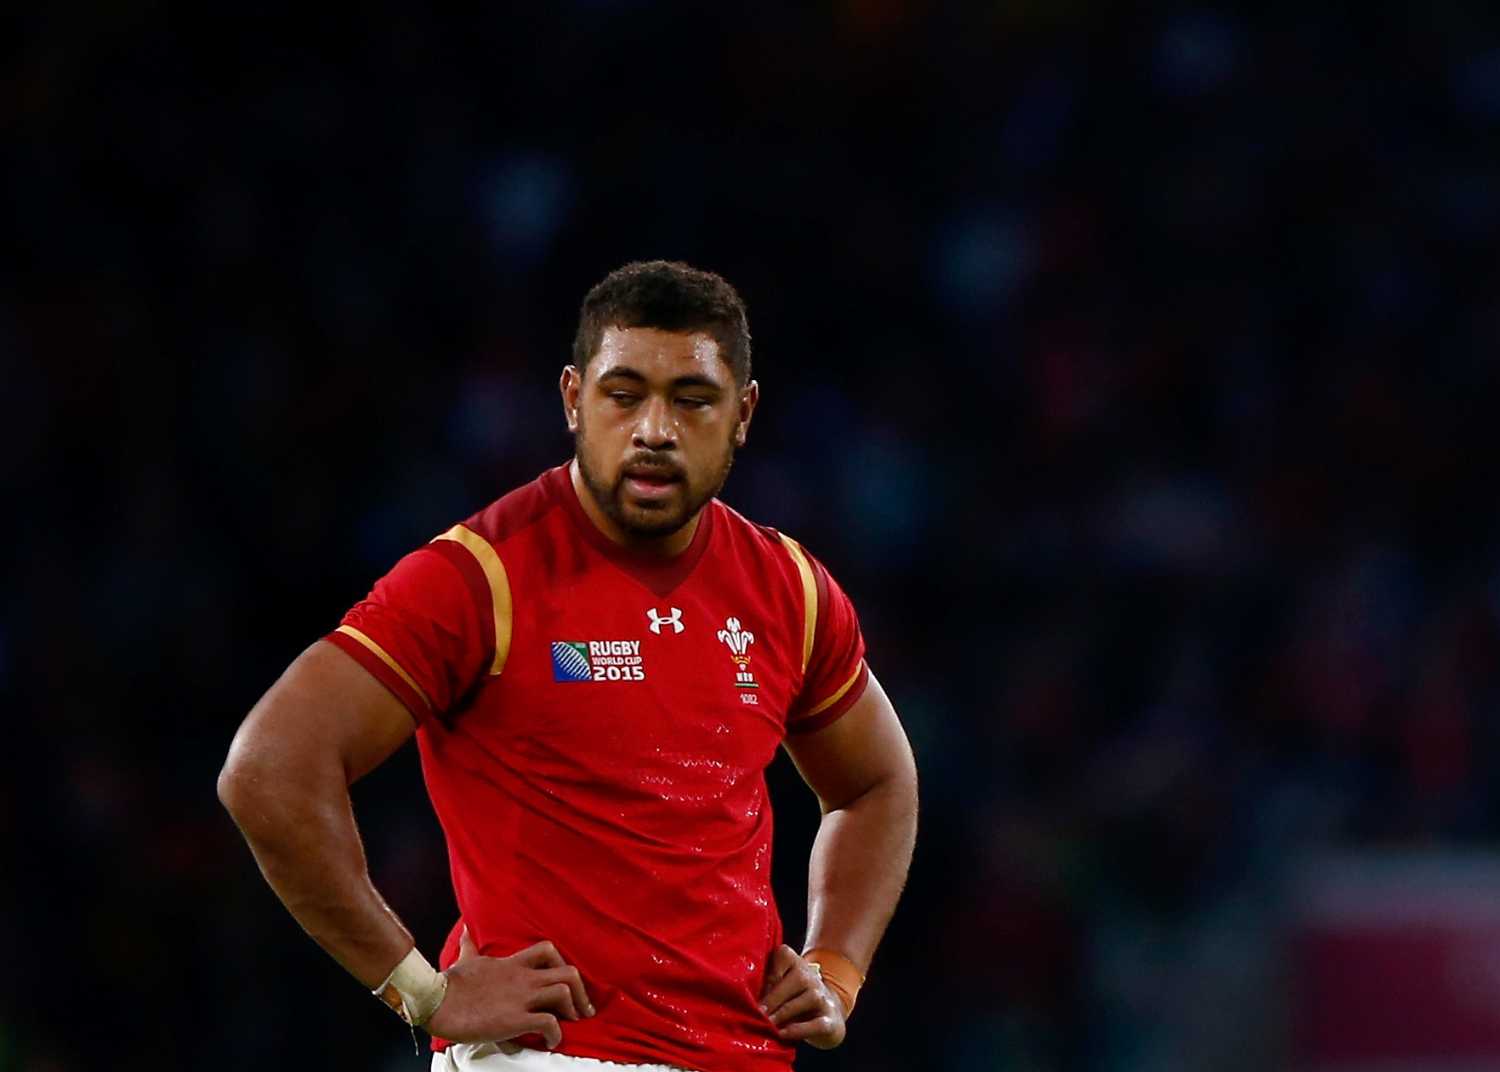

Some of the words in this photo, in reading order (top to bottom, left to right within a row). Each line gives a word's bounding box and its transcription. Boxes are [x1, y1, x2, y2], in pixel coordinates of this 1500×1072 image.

[590, 641, 640, 656] RUGBY
[592, 656, 624, 666] WORLD
[624, 656, 642, 666] CUP
[592, 665, 645, 681] 2015
